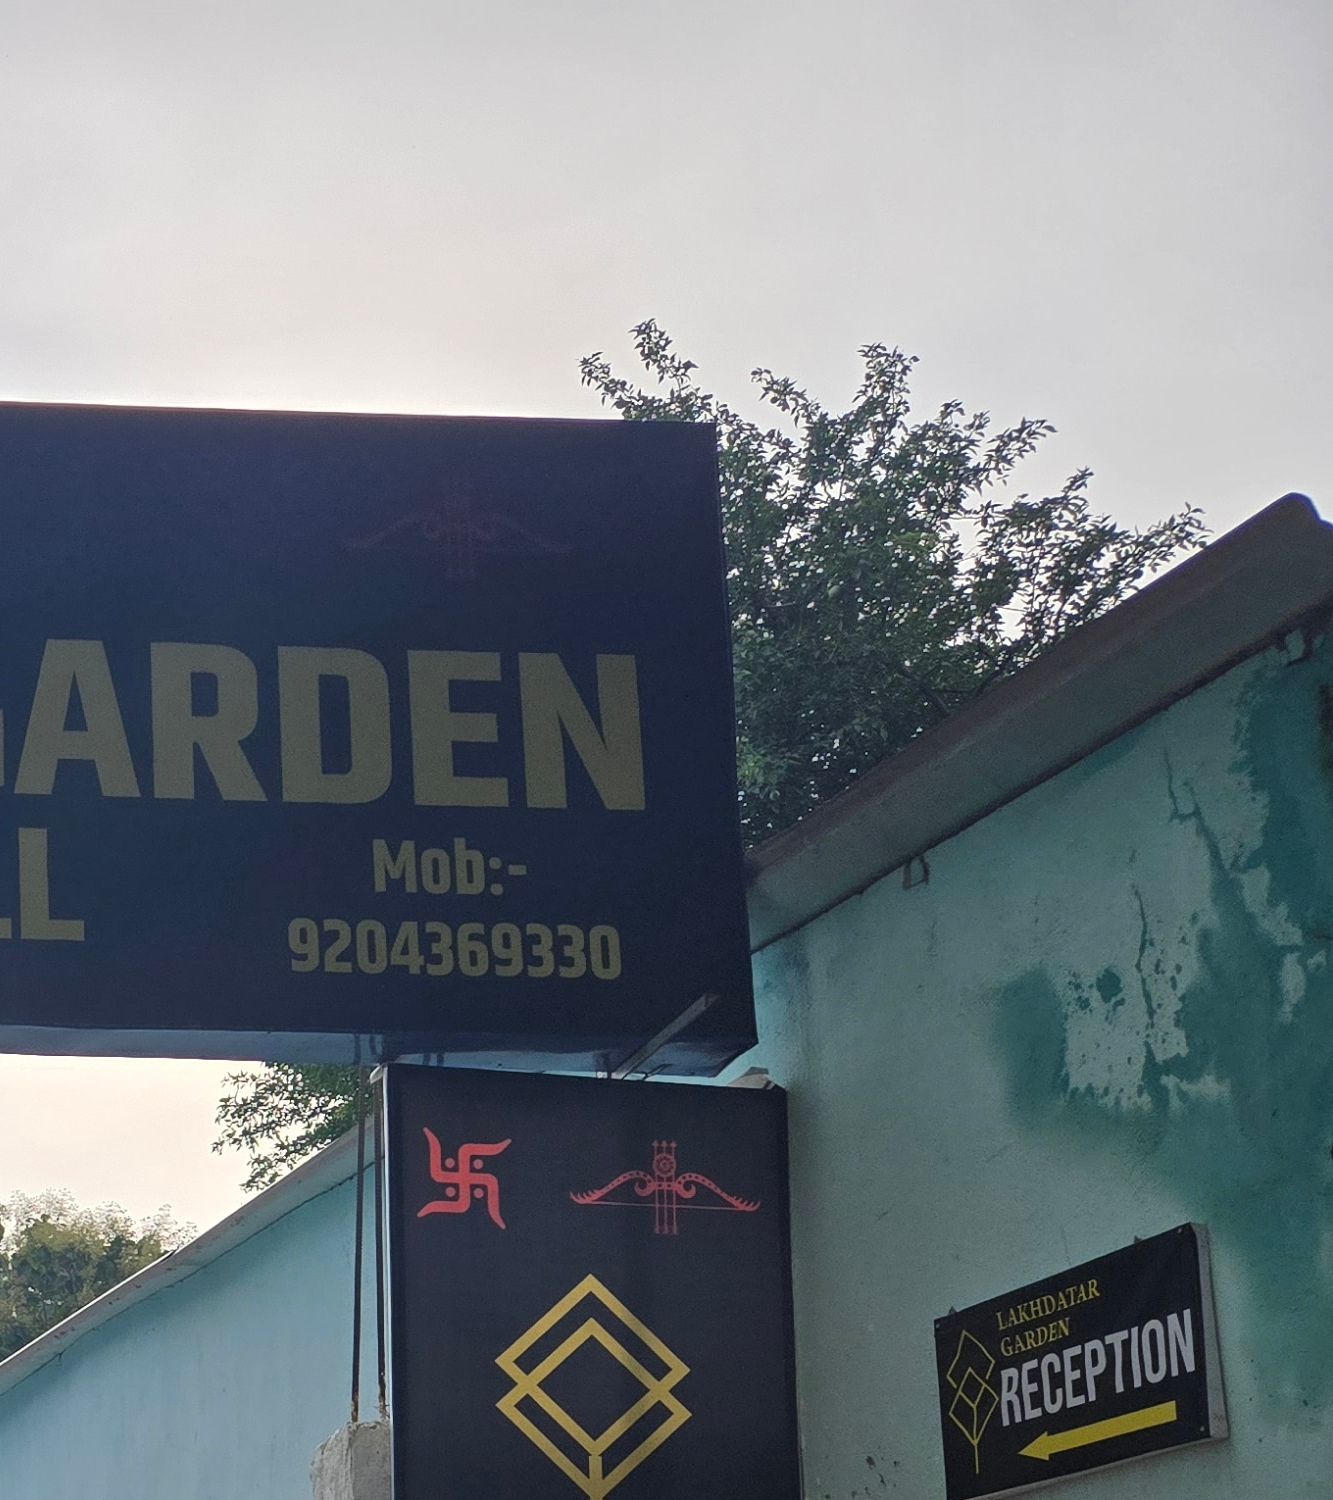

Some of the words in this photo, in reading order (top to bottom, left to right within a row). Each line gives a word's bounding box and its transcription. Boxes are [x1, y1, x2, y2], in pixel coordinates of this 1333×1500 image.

[371, 838, 529, 898] Mob:-
[285, 916, 623, 982] 9204369330
[995, 1278, 1101, 1331] LAKHDATAR
[1000, 1317, 1071, 1357] GARDEN
[1000, 1308, 1196, 1427] RECEPTION
